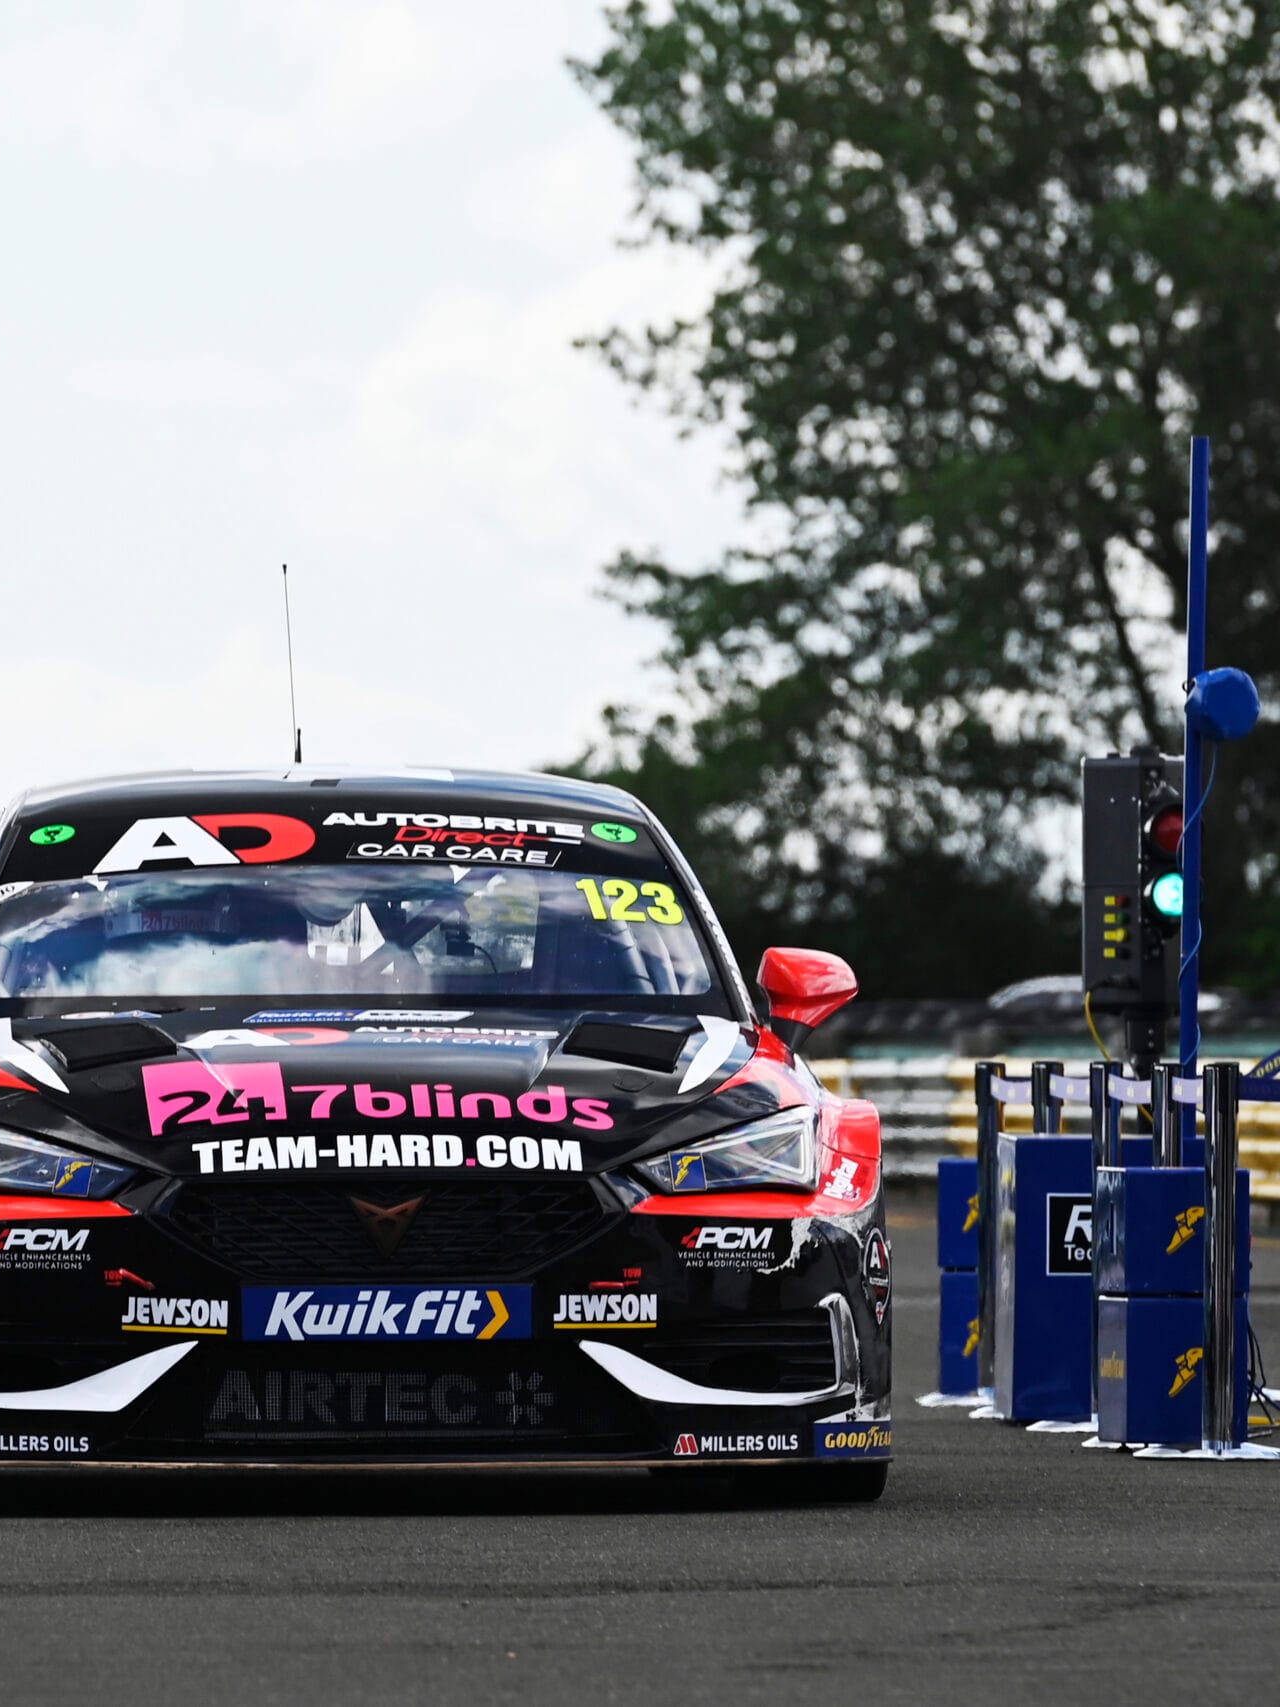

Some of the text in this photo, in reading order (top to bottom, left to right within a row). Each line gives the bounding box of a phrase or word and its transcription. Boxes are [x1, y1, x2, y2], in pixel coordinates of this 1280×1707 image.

[322, 812, 585, 838] AUTOBRITE
[394, 826, 526, 847] Direct
[356, 843, 549, 864] CAR CARE
[576, 878, 683, 926] 123
[192, 1134, 583, 1173] TEAM-HARD.COM
[14, 1262, 83, 1270] MODIFICATIONS
[21, 1252, 91, 1262] ENHANCEMENTS
[678, 1251, 775, 1261] VEHICLE ENHANCEMENTS
[685, 1259, 769, 1268] AND MODIFICATIONS
[122, 1296, 229, 1328] JEWSON
[553, 1294, 657, 1322] JEWSON
[210, 1370, 477, 1424] AIRTEC
[53, 1436, 89, 1453] OILS
[700, 1434, 799, 1452] MILLERS OILS
